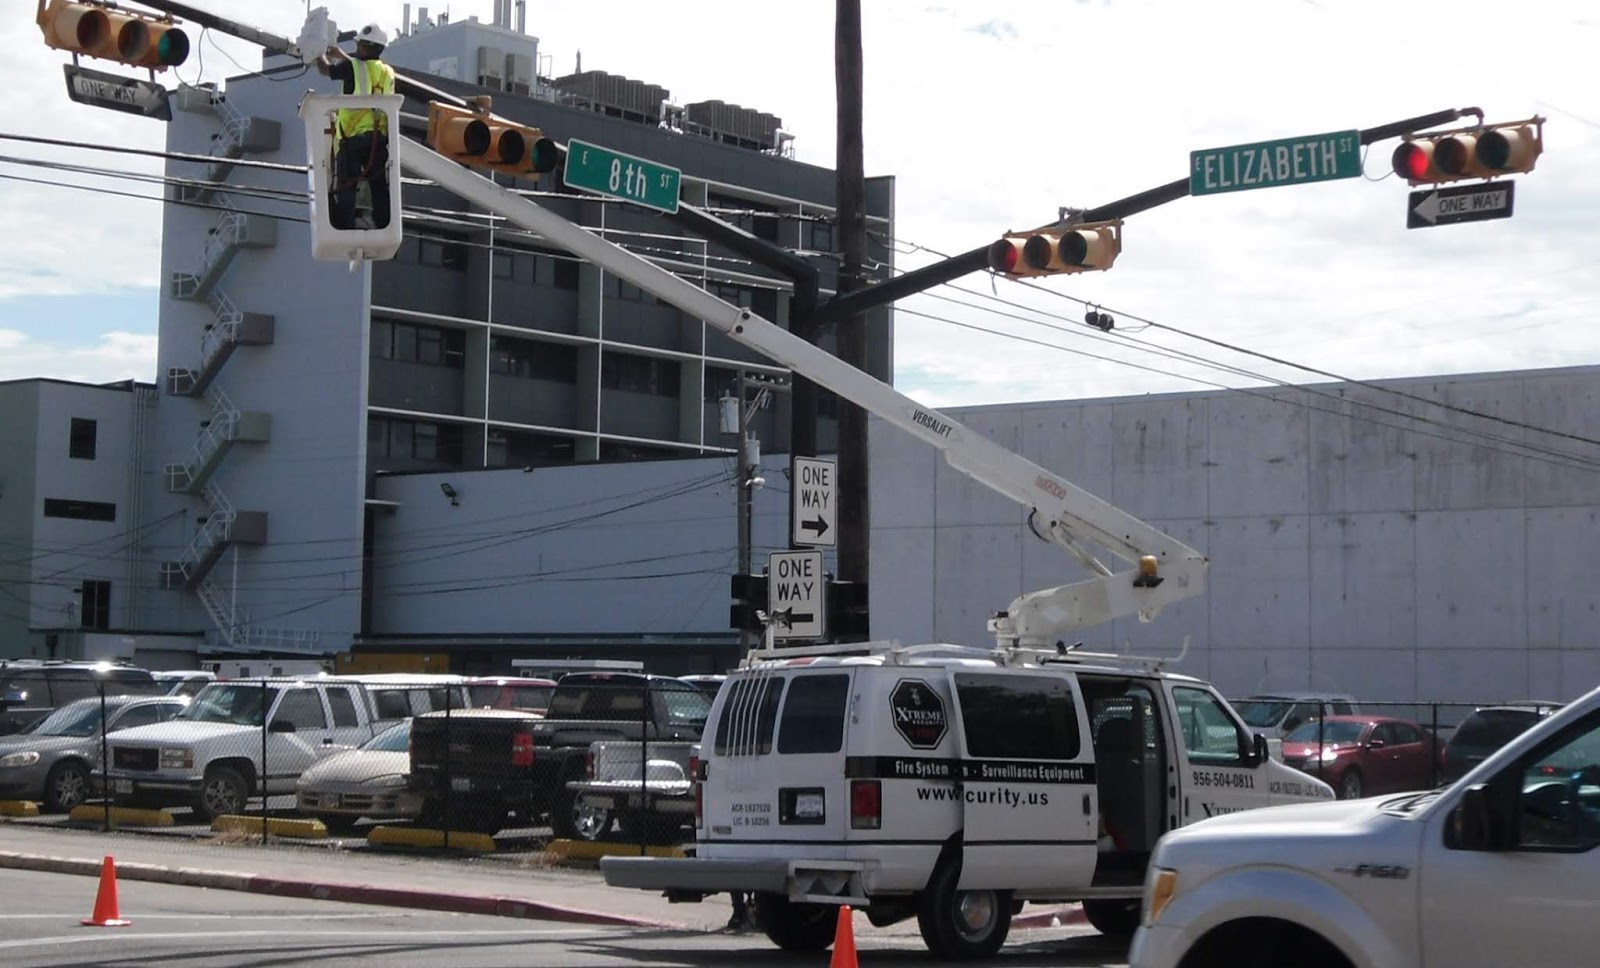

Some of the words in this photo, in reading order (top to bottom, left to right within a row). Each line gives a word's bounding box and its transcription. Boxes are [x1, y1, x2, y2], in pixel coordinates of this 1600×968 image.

[81, 79, 105, 97] ONE
[114, 84, 136, 103] WAY
[1195, 156, 1201, 171] E
[1204, 139, 1337, 190] ELIZABETH
[1340, 137, 1353, 153] ST
[582, 150, 589, 165] E
[609, 157, 648, 199] 8th
[660, 172, 672, 189] ST
[1440, 196, 1468, 214] ONE
[1473, 191, 1503, 210] WAY
[912, 408, 953, 438] VERSALIFT
[803, 466, 829, 486] ONE
[801, 489, 830, 509] WAY
[778, 558, 813, 578] ONE
[777, 581, 814, 601] WAY
[895, 761, 914, 775] Fire
[916, 762, 949, 777] System
[982, 764, 1038, 779] Surveillance
[1039, 766, 1085, 781] Equipment
[1193, 771, 1255, 789] 956-504-0811
